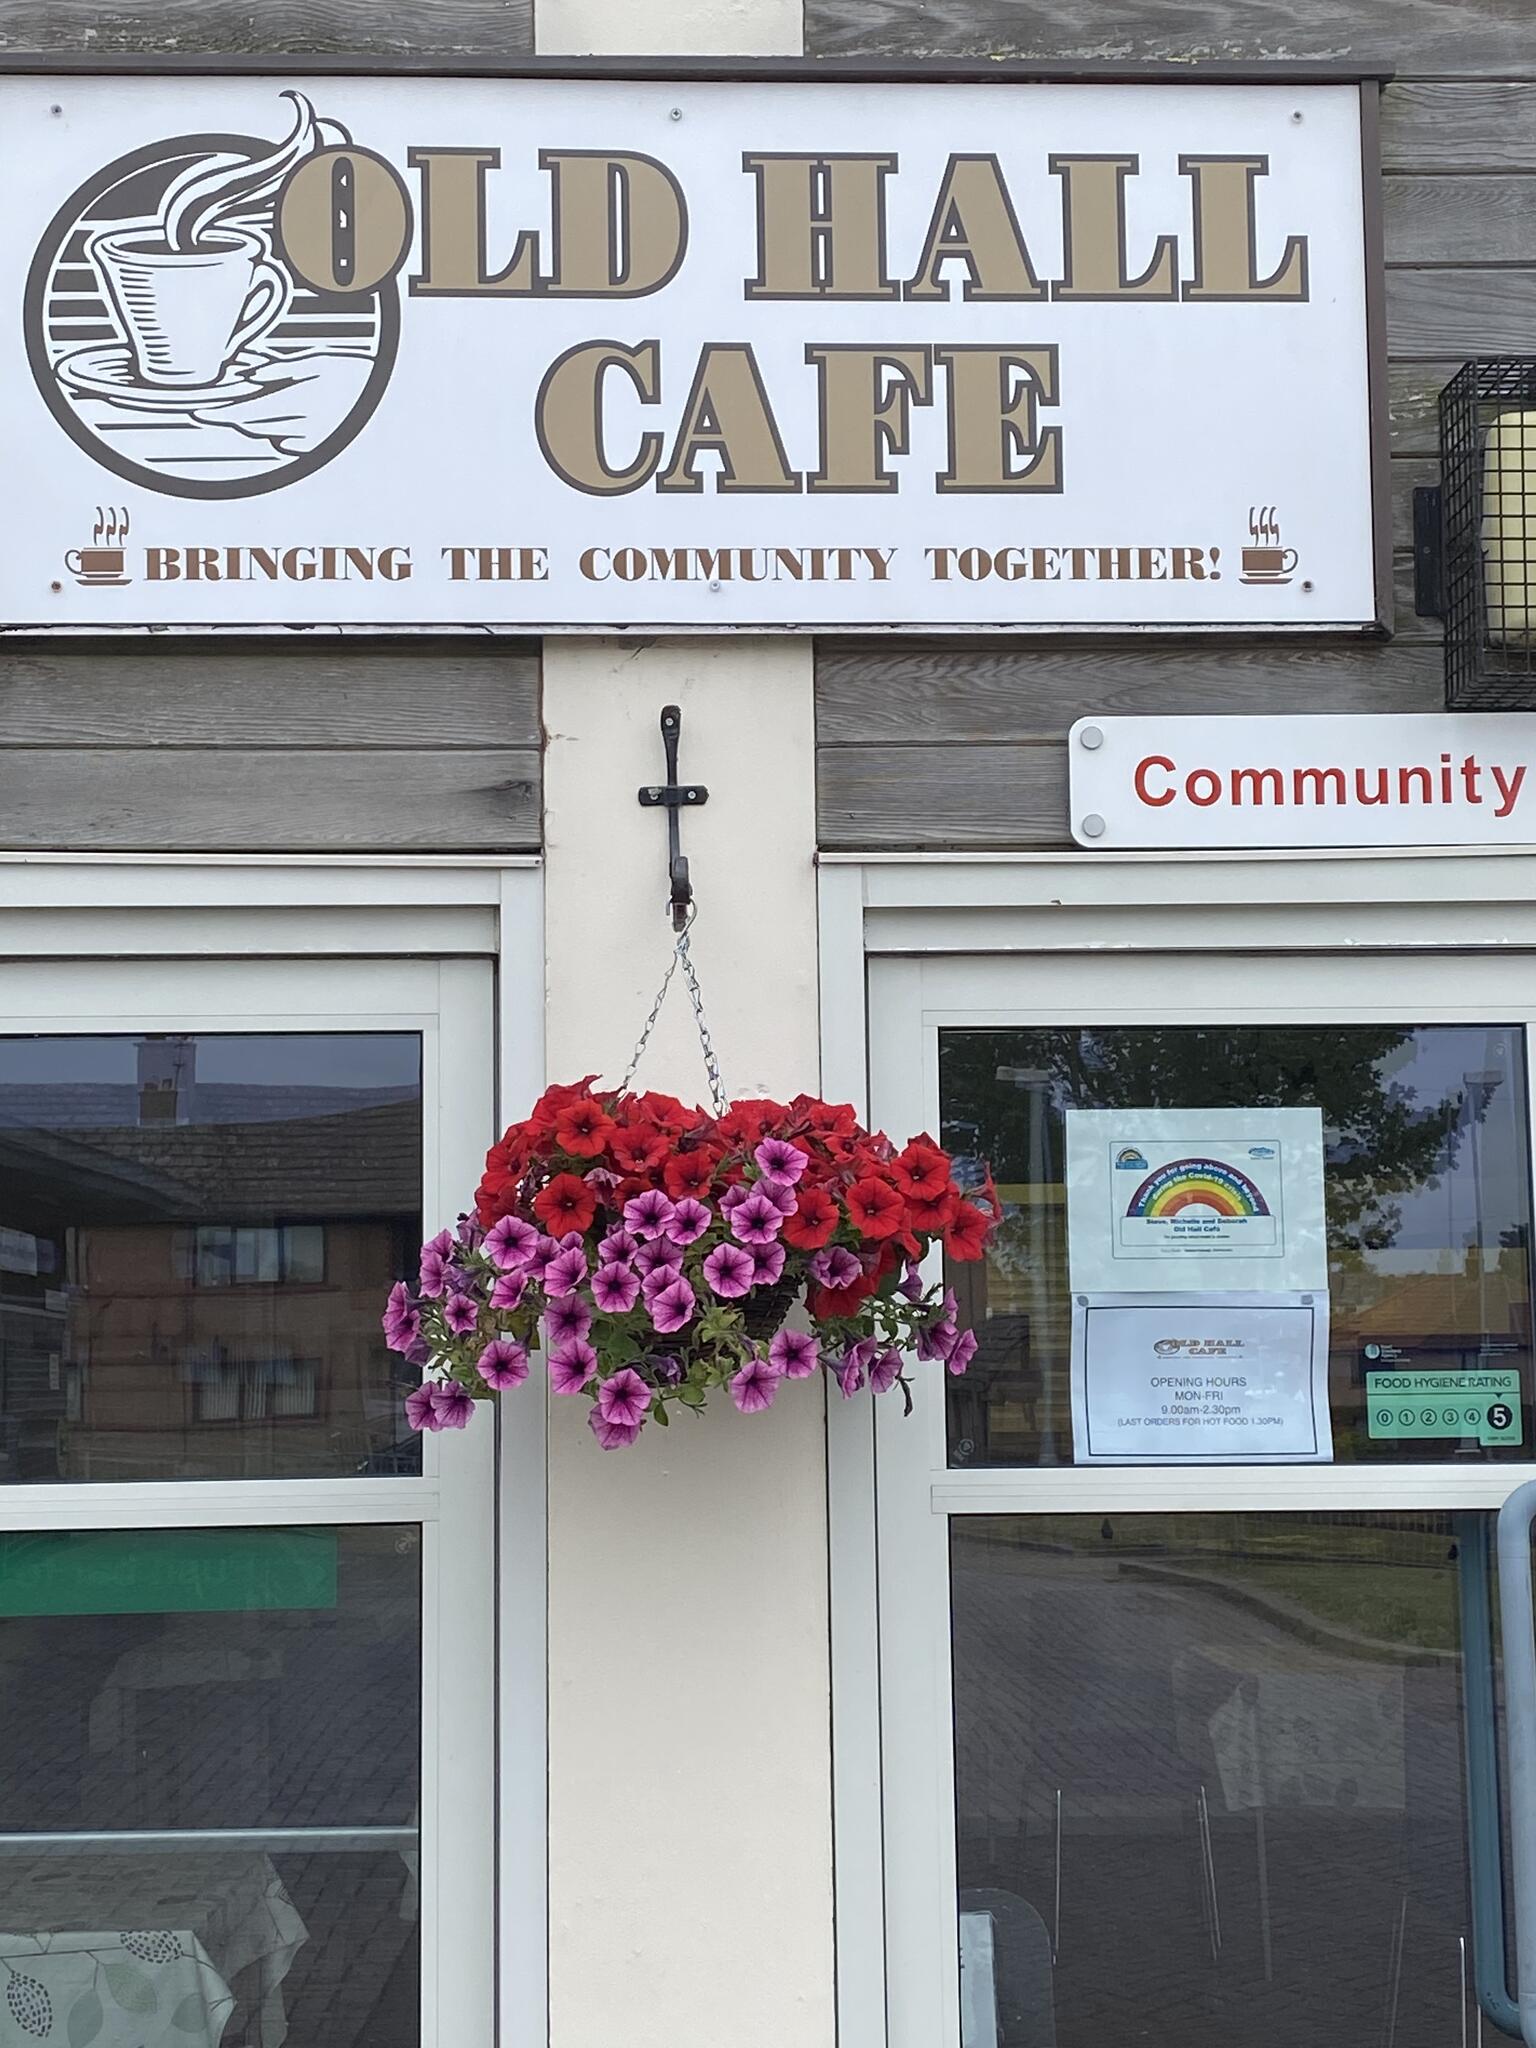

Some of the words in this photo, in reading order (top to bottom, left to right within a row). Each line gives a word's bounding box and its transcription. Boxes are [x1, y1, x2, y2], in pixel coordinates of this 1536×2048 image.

[278, 143, 688, 299] OLD
[742, 152, 1309, 302] HALL
[535, 340, 1064, 496] CAFE
[144, 547, 413, 581] BRINGING
[441, 547, 549, 581] THE
[579, 547, 897, 581] COMMUNITY
[925, 547, 1222, 581] TOGETHER!
[1134, 753, 1527, 818] Community
[1138, 1184, 1155, 1208] Thank
[1154, 1173, 1167, 1186] you
[1166, 1167, 1178, 1176] for
[1179, 1163, 1202, 1173] going
[1203, 1163, 1228, 1175] above
[1228, 1172, 1244, 1187] and
[1173, 1173, 1188, 1183] the
[1188, 1172, 1224, 1185] Covid-19
[1151, 1377, 1203, 1388] OPENING
[1206, 1376, 1247, 1387] HOURS
[1374, 1378, 1411, 1389] FOOD
[1414, 1377, 1466, 1388] HYGIENE
[1468, 1376, 1512, 1387] RATING
[1175, 1391, 1224, 1401] MON-FRI
[1161, 1404, 1241, 1417] 9.00am-2.30pm
[1381, 1413, 1389, 1423] 0
[1425, 1412, 1433, 1422] 2
[1447, 1412, 1455, 1422] 3
[1468, 1412, 1476, 1422] 4
[1493, 1407, 1507, 1427] 5
[1117, 1417, 1142, 1427] (LAST
[1144, 1417, 1180, 1426] ORDERS
[1182, 1417, 1201, 1426] FOR
[1203, 1417, 1221, 1426] HOT
[1223, 1417, 1249, 1426] FOOD
